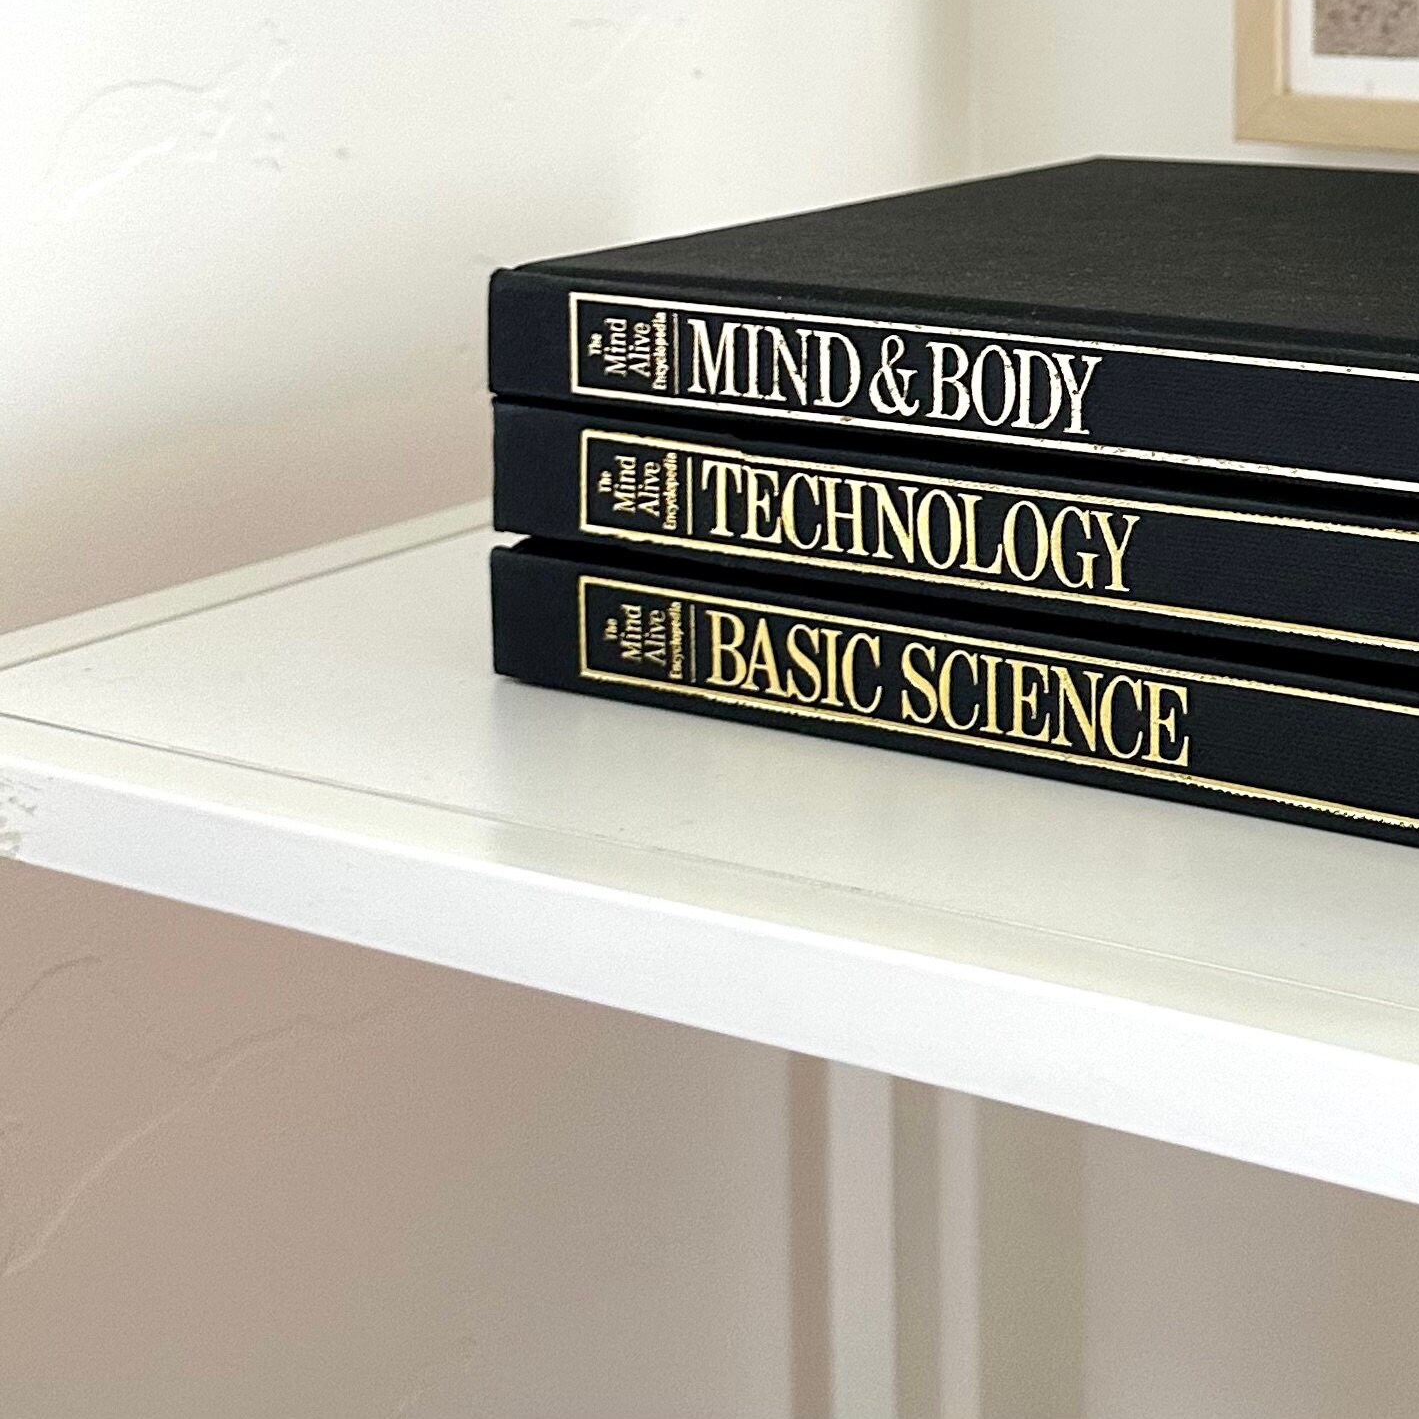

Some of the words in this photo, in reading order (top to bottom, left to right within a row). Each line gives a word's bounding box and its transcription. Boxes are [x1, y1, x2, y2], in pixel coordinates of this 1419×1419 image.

[589, 333, 603, 357] The
[603, 318, 629, 378] Mind
[628, 322, 654, 379] Alive
[653, 311, 669, 392] Encyclopedia
[687, 318, 861, 408] MIND
[869, 335, 920, 415] &
[926, 341, 1103, 436] BODY
[599, 471, 612, 494] The
[613, 456, 637, 514] Mind
[638, 461, 662, 517] Alive
[662, 452, 678, 531] Encyclopedia
[702, 459, 1141, 593] TECHNOLOGY
[604, 618, 618, 642] The
[620, 603, 645, 663] Mind
[645, 610, 668, 667] Alive
[669, 601, 685, 680] Encyclopedia
[704, 609, 884, 713] BASIC
[901, 641, 1190, 768] SCIENCE
